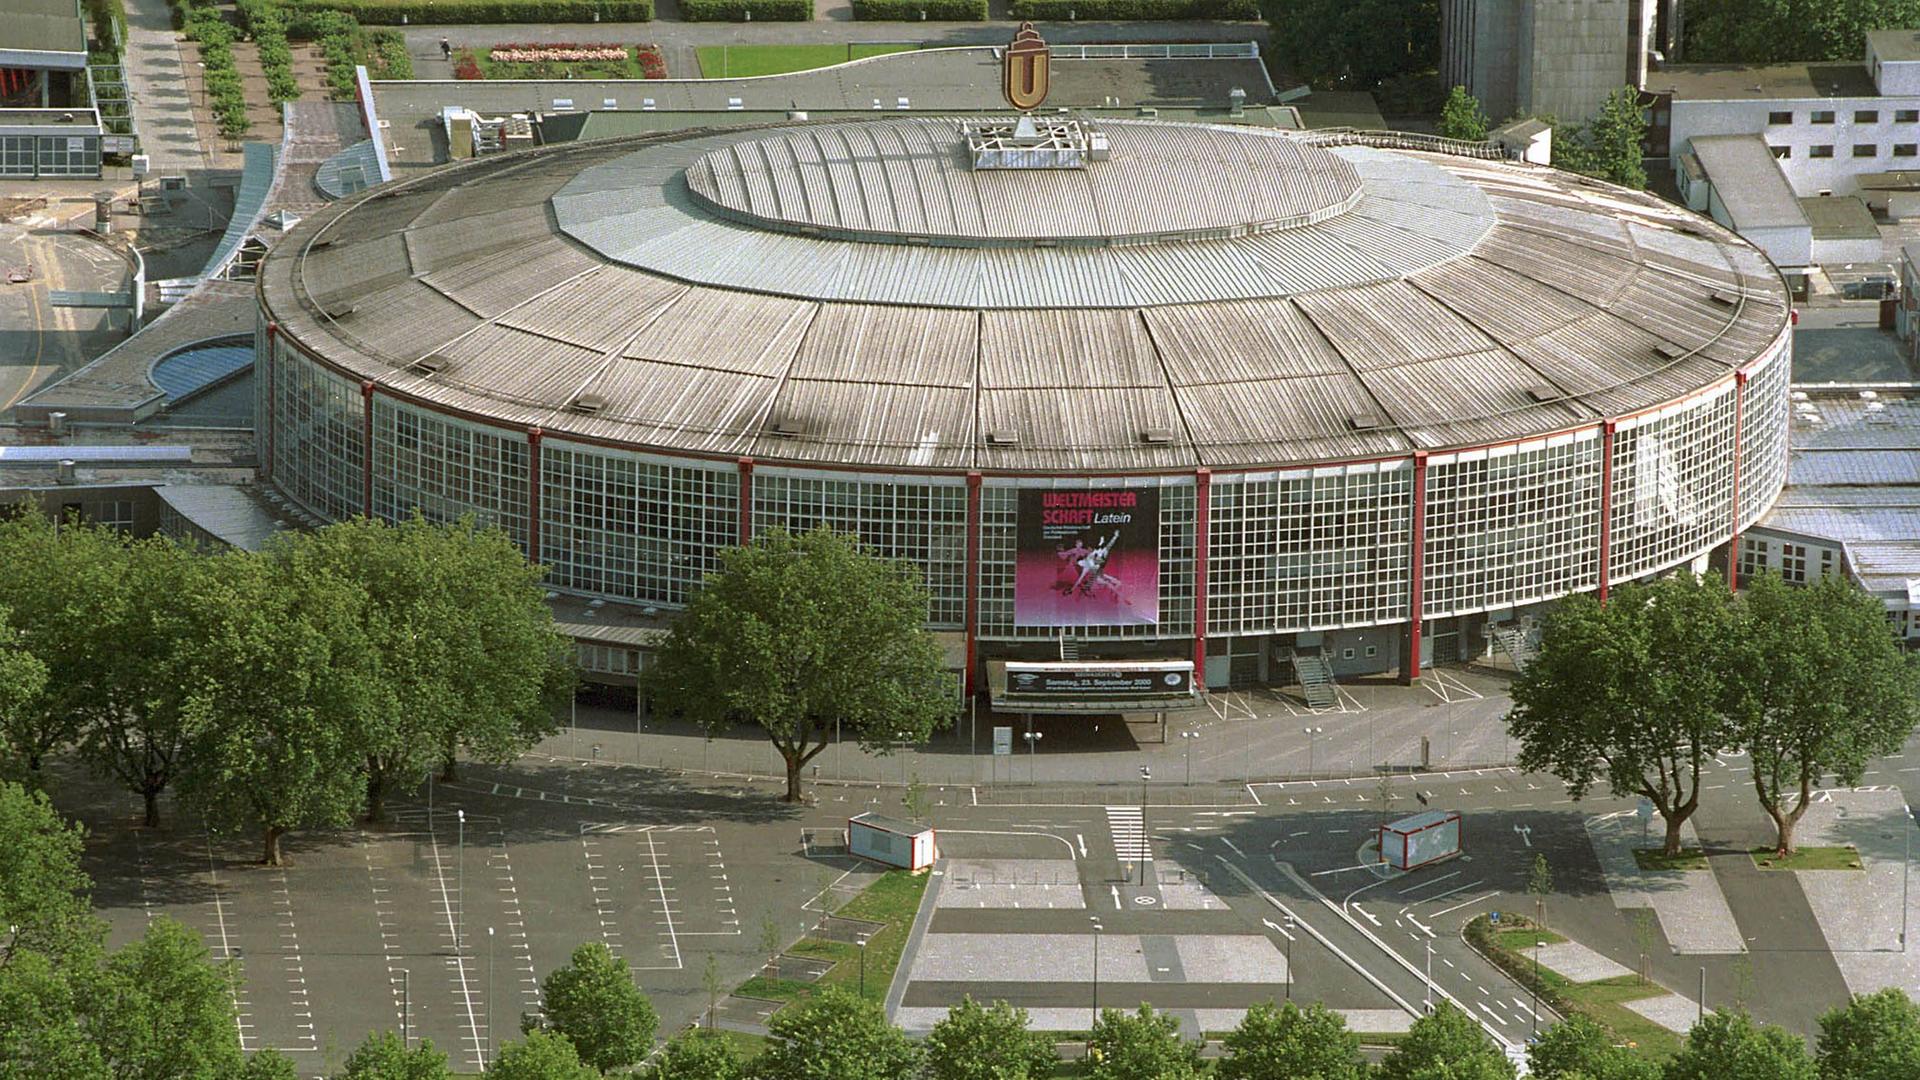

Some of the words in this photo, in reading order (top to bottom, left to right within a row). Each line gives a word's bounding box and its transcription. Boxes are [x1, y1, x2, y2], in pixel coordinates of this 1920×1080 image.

[1010, 55, 1046, 107] U
[1043, 492, 1136, 507] WELTMEISTER
[1043, 510, 1094, 524] SCHAFT
[1094, 513, 1131, 524] Latein
[1046, 679, 1079, 687] Samstag,
